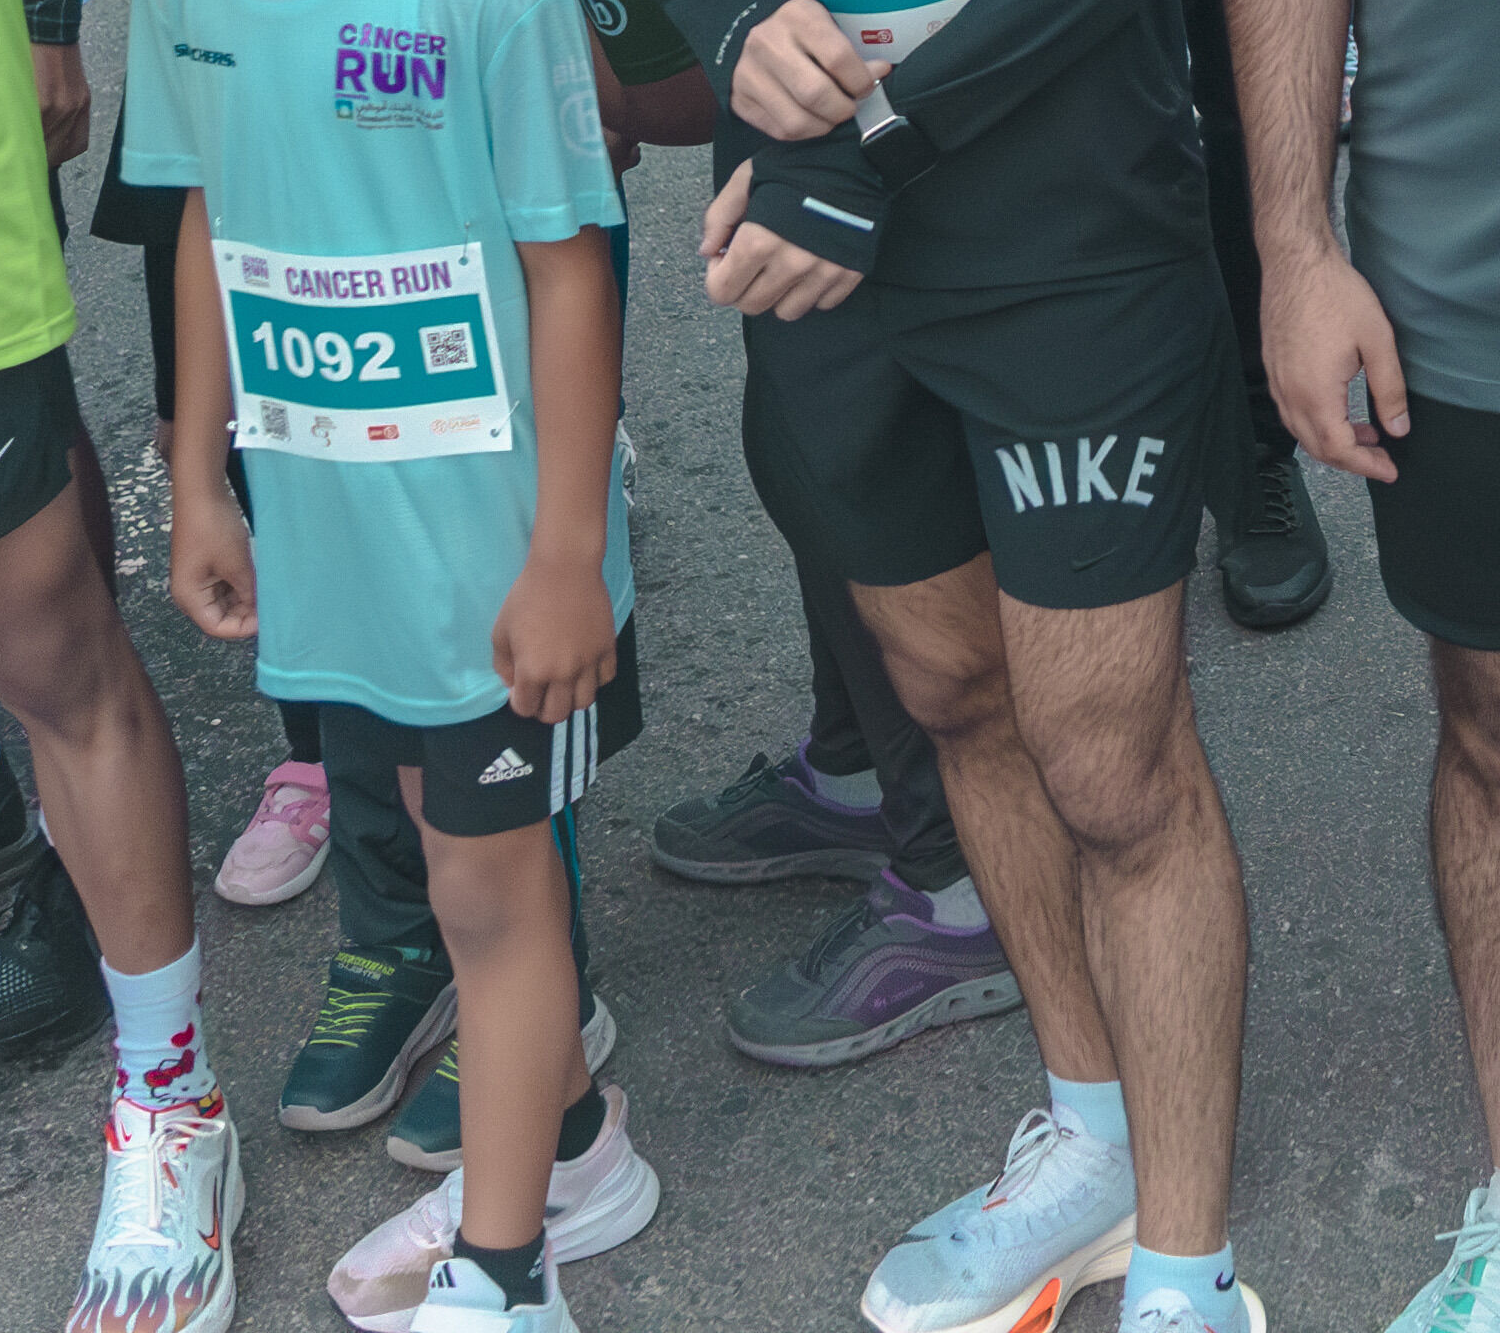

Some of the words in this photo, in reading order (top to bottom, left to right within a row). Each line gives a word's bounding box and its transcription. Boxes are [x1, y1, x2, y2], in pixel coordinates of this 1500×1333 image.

[338, 23, 446, 56] CANCER
[335, 48, 446, 100] RUN
[285, 265, 386, 299] CANCER
[391, 260, 452, 293] RUN
[252, 320, 401, 382] 1092
[995, 434, 1166, 514] NIKE
[478, 763, 534, 785] adidas
